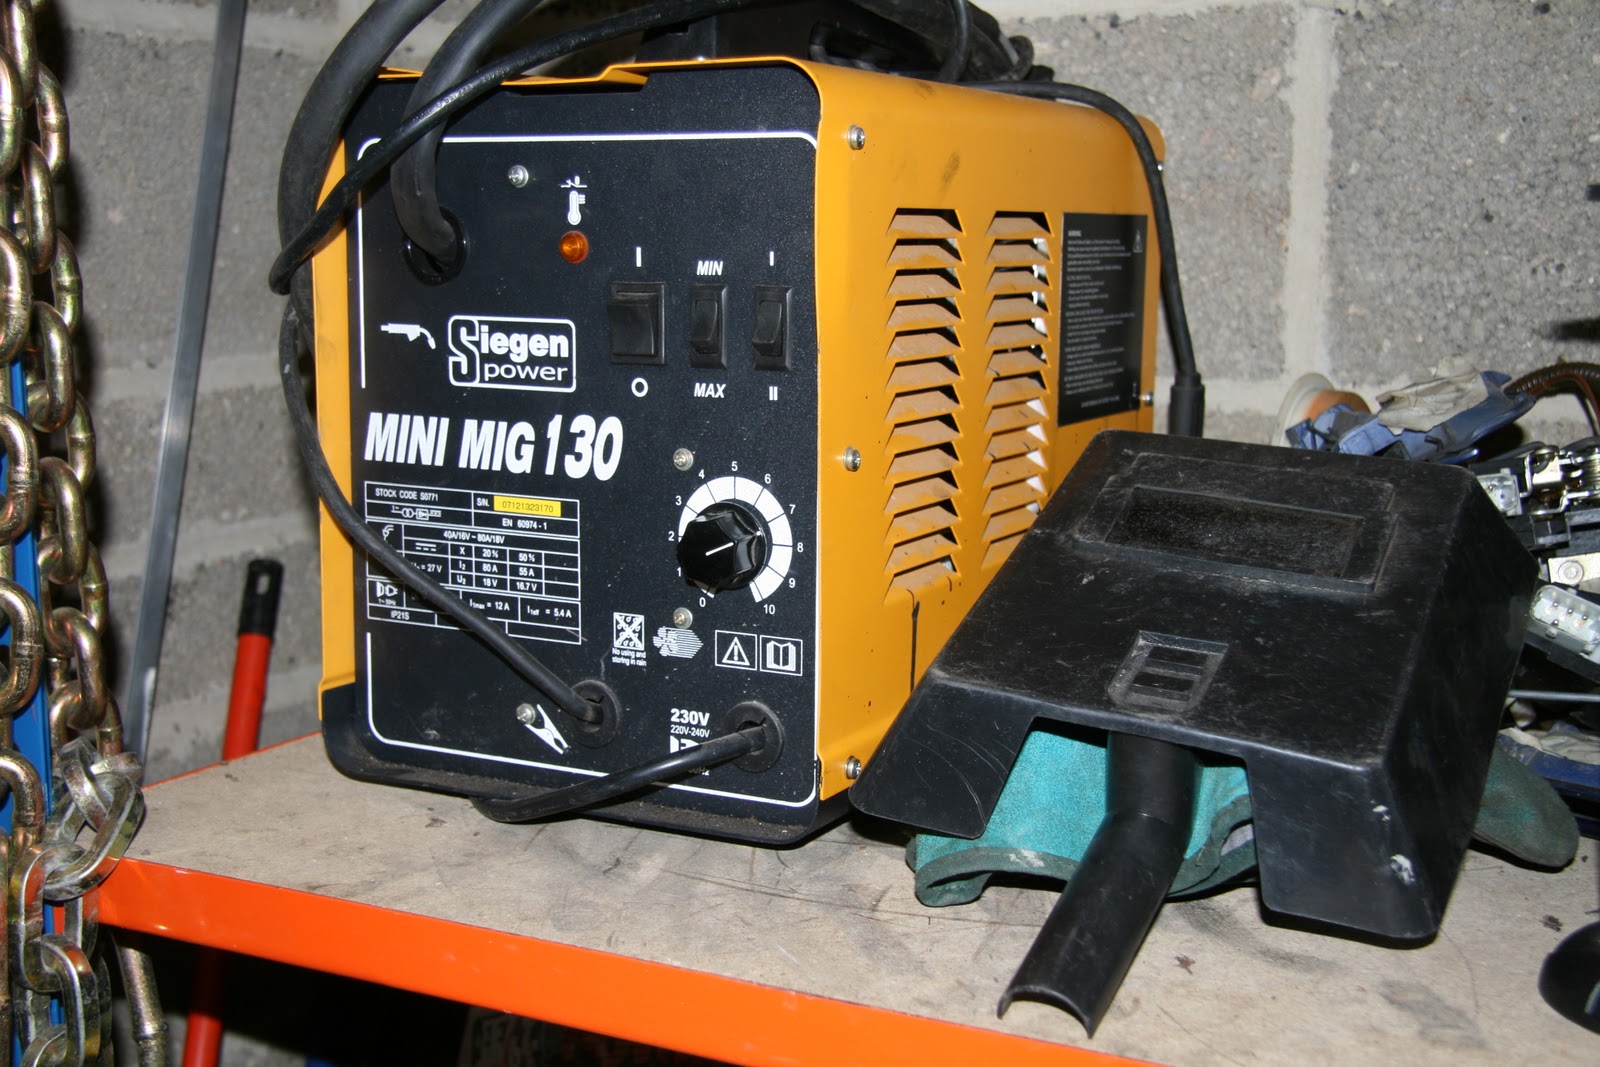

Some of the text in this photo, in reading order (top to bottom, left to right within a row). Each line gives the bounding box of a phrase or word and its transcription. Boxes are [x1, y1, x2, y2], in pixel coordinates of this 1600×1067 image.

[696, 260, 724, 276] MIN
[448, 315, 569, 387] Siegen
[484, 363, 569, 382] power
[694, 382, 726, 399] MAX
[364, 412, 624, 481] MINI MIG 130
[731, 461, 738, 471] 5
[698, 469, 705, 479] 4
[764, 474, 771, 484] 6
[375, 487, 439, 502] STOCK CODE S0771
[675, 495, 682, 505] 3
[789, 504, 796, 514] 7
[502, 518, 513, 527] EN
[668, 531, 675, 541] 2
[459, 547, 466, 555] X
[797, 542, 804, 553] 8
[676, 567, 682, 577] 1
[788, 577, 796, 588] 9
[699, 597, 706, 607] 0
[764, 604, 776, 615] 10
[612, 647, 620, 655] No
[620, 649, 635, 659] using
[612, 656, 630, 666] storing
[636, 658, 647, 667] rain
[670, 708, 710, 726] 230V
[670, 724, 710, 738] 220V-240V
